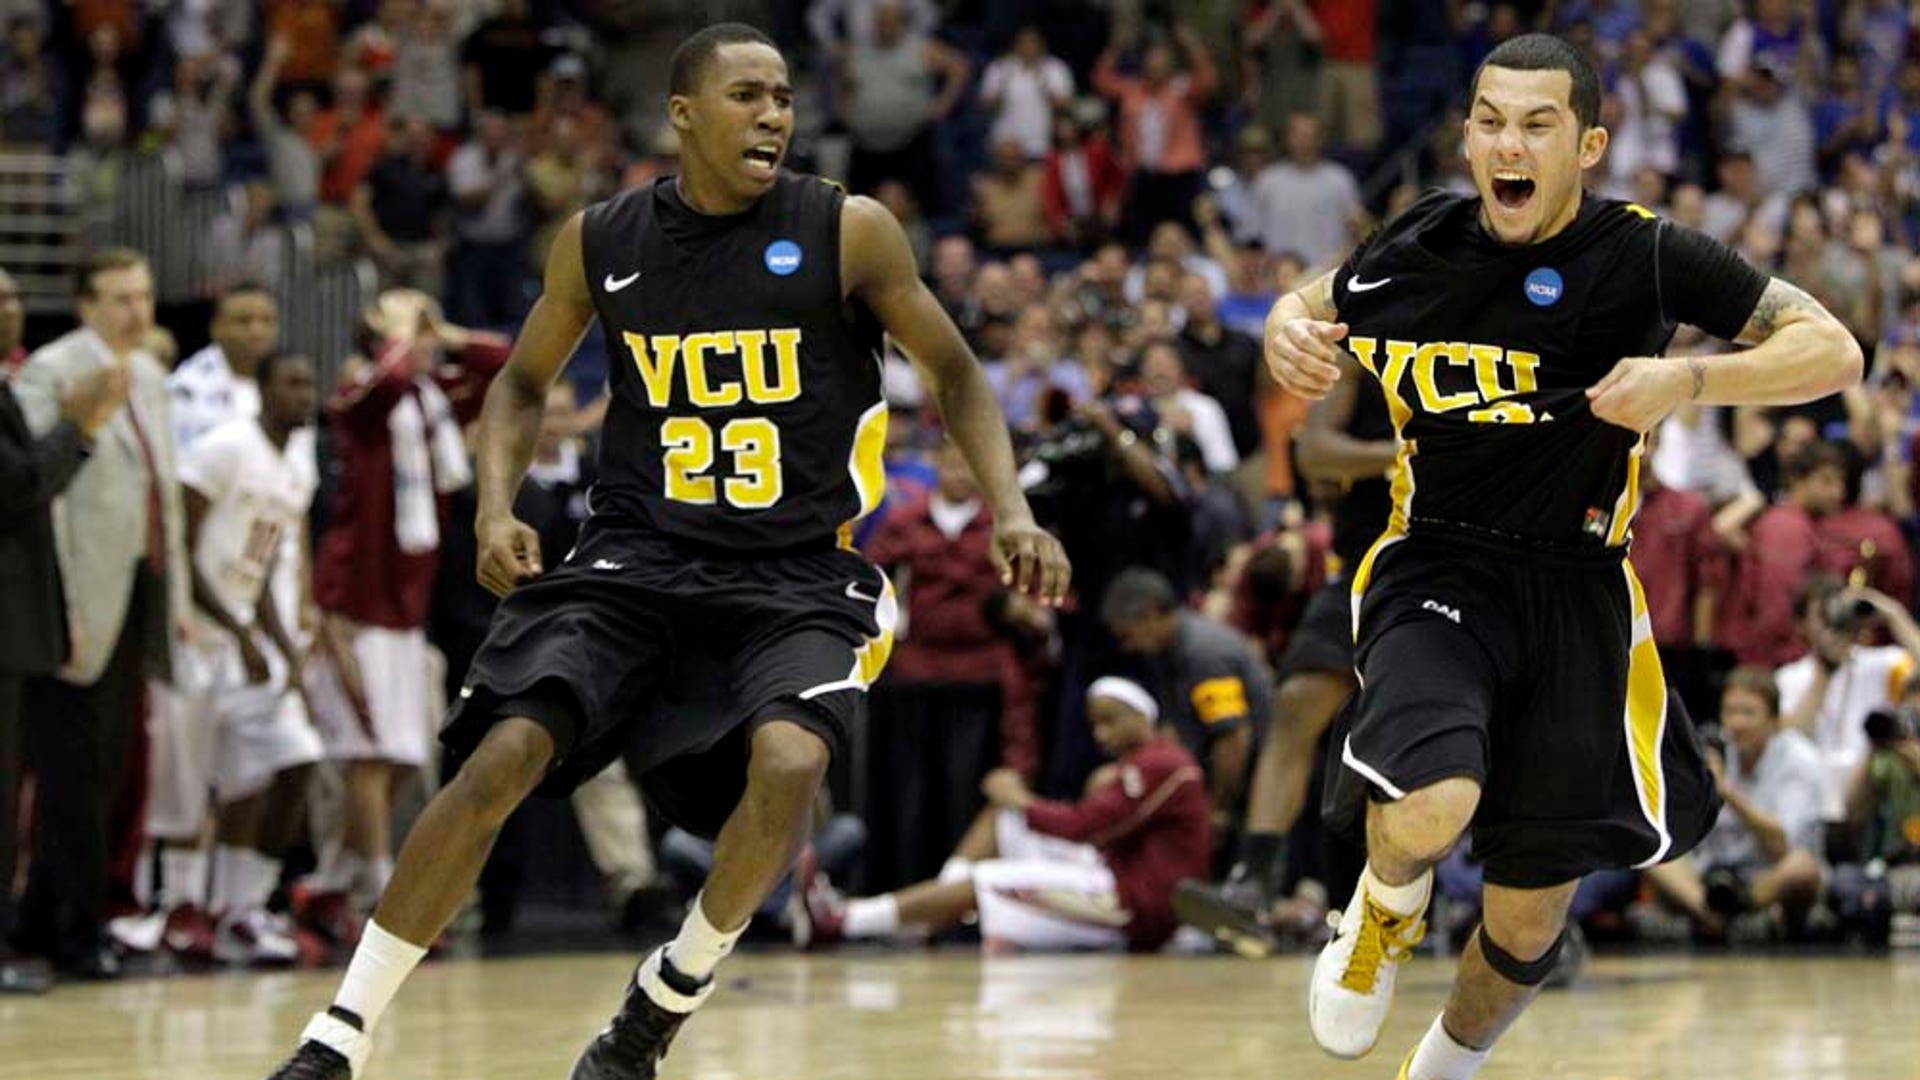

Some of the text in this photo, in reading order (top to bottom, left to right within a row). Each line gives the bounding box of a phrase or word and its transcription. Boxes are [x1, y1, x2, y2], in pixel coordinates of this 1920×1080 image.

[622, 328, 802, 407] VCU
[1349, 337, 1540, 415] VCU
[660, 417, 783, 509] 23
